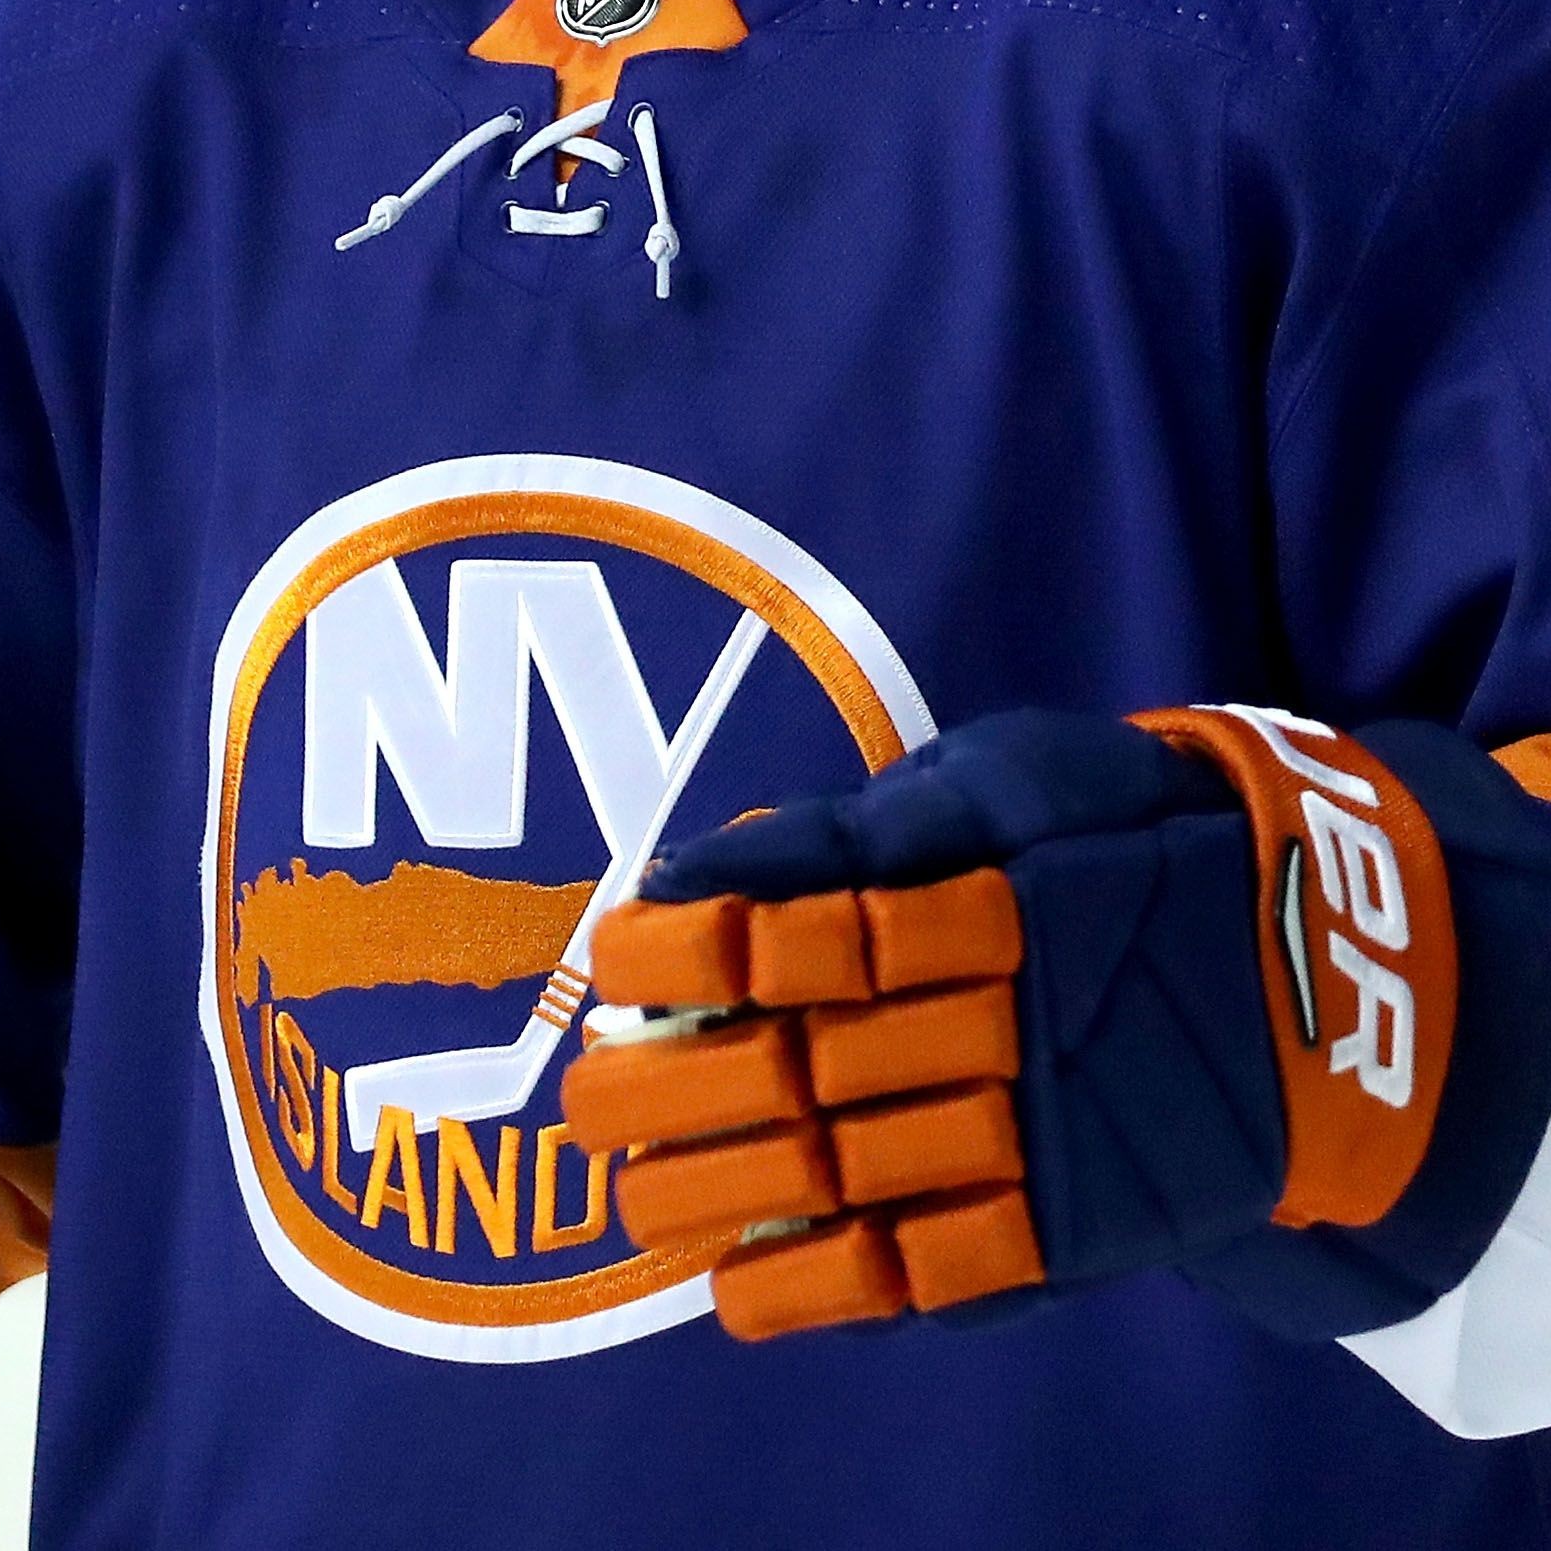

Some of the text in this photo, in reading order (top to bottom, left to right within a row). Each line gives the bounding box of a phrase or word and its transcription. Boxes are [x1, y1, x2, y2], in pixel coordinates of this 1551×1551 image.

[302, 556, 772, 858] NY
[1188, 703, 1414, 1109] UER
[260, 1003, 648, 1258] ISLAND
